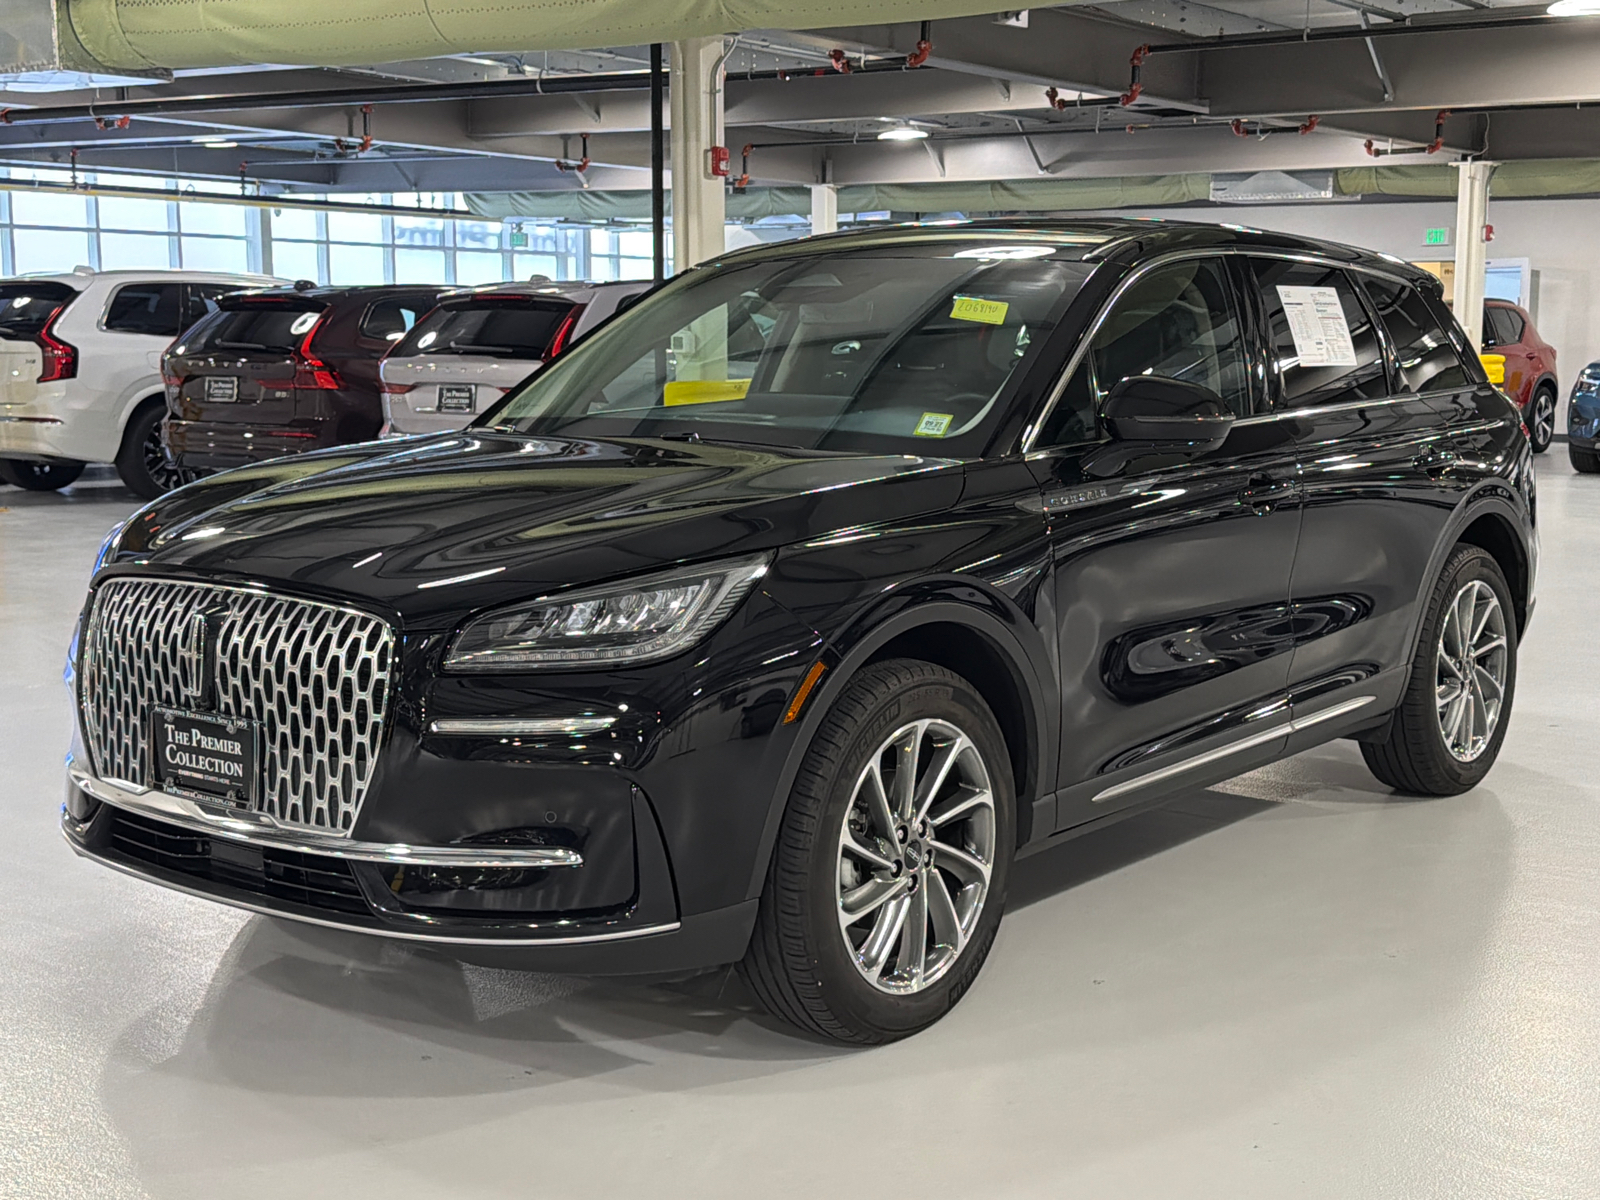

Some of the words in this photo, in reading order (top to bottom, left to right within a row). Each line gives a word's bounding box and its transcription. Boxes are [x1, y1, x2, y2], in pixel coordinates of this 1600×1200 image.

[1050, 489, 1108, 506] CORSAIR
[154, 705, 185, 718] AUTOMOTIVE
[186, 710, 217, 724] EXCELLENCE
[164, 724, 190, 745] THE
[190, 728, 243, 756] PREMIER
[847, 701, 899, 775] MICHELIN
[165, 743, 243, 778] COLLECTION
